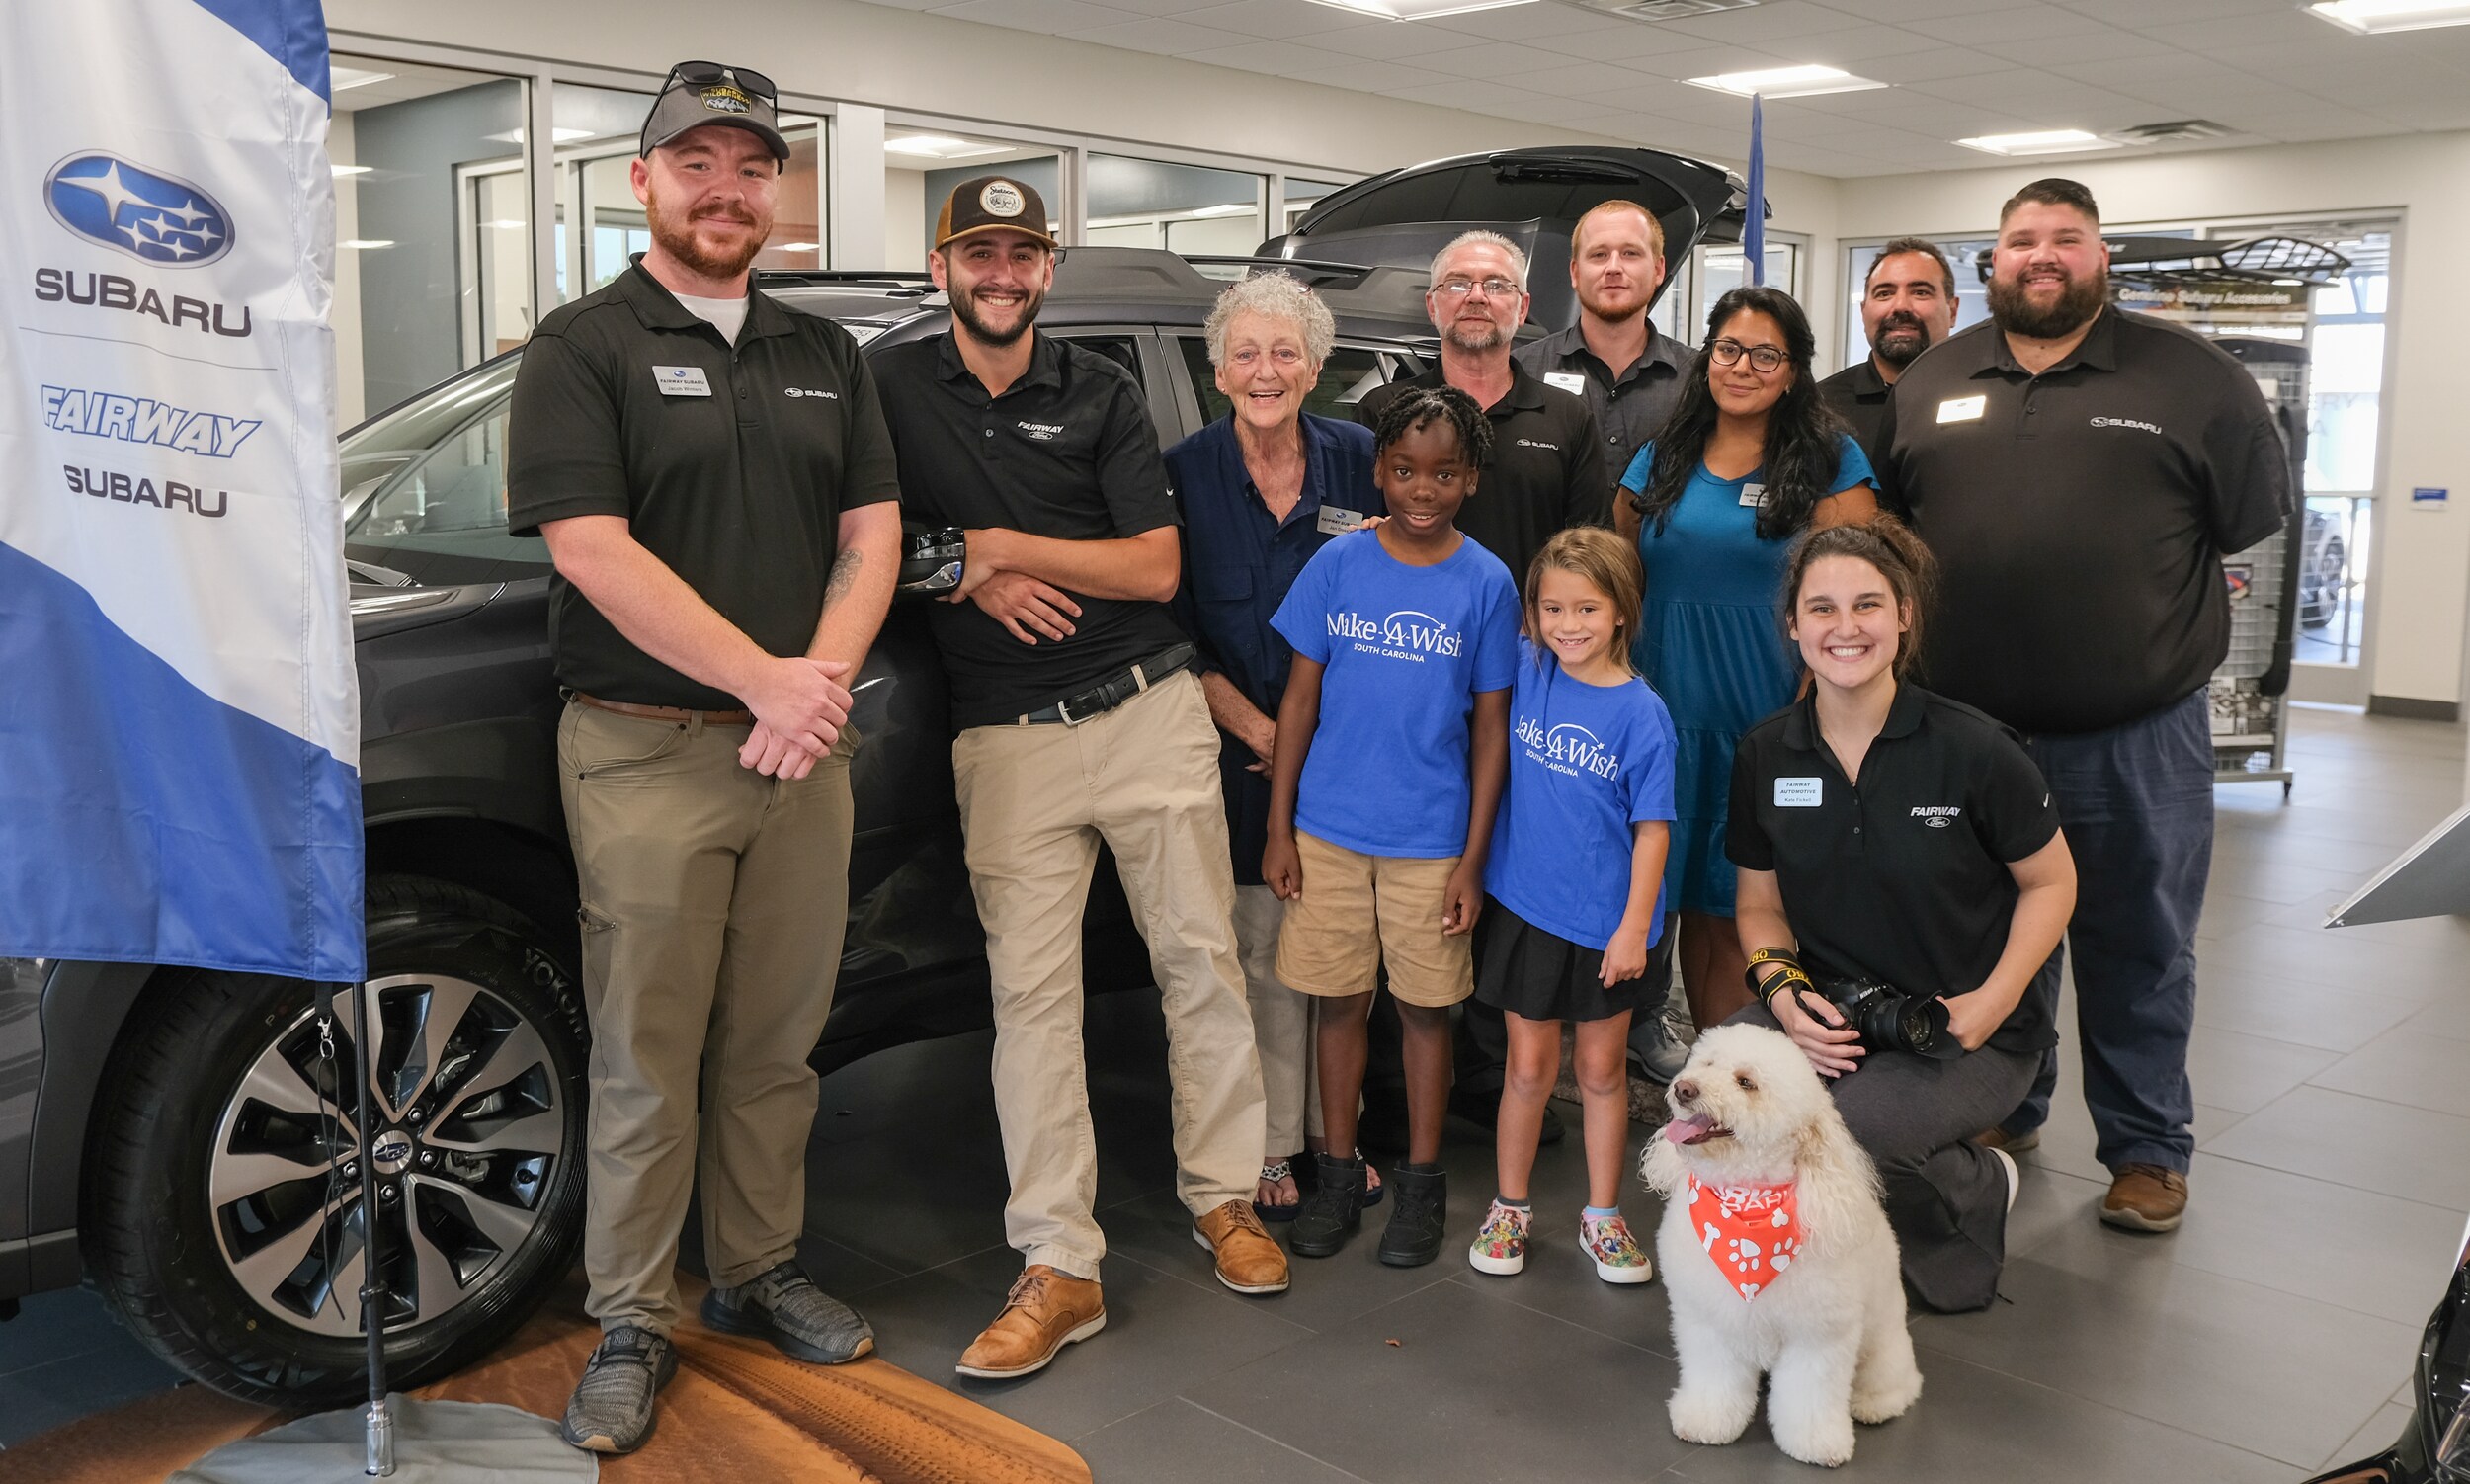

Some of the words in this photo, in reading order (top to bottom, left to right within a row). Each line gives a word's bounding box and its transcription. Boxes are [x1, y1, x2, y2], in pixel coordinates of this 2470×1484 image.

[35, 268, 252, 337] SUBARU
[2118, 288, 2176, 302] Genuine
[2177, 290, 2223, 304] Subaru
[805, 390, 838, 399] SUBARU
[41, 384, 263, 458] FAIRWAY
[1018, 421, 1064, 433] FAIRWAY
[2108, 418, 2163, 434] SUBARU
[1531, 441, 1559, 451] SUBARU
[63, 465, 227, 518] SUBARU
[1326, 612, 1462, 657] Make-A-Wish
[1354, 642, 1380, 655] SOUTH
[1381, 648, 1425, 663] CAROLINA
[1525, 748, 1545, 764] SOUTH
[1545, 761, 1579, 778] CAROLINA
[1910, 806, 1961, 817] FAIRWAY
[614, 1333, 635, 1344] DUDE
